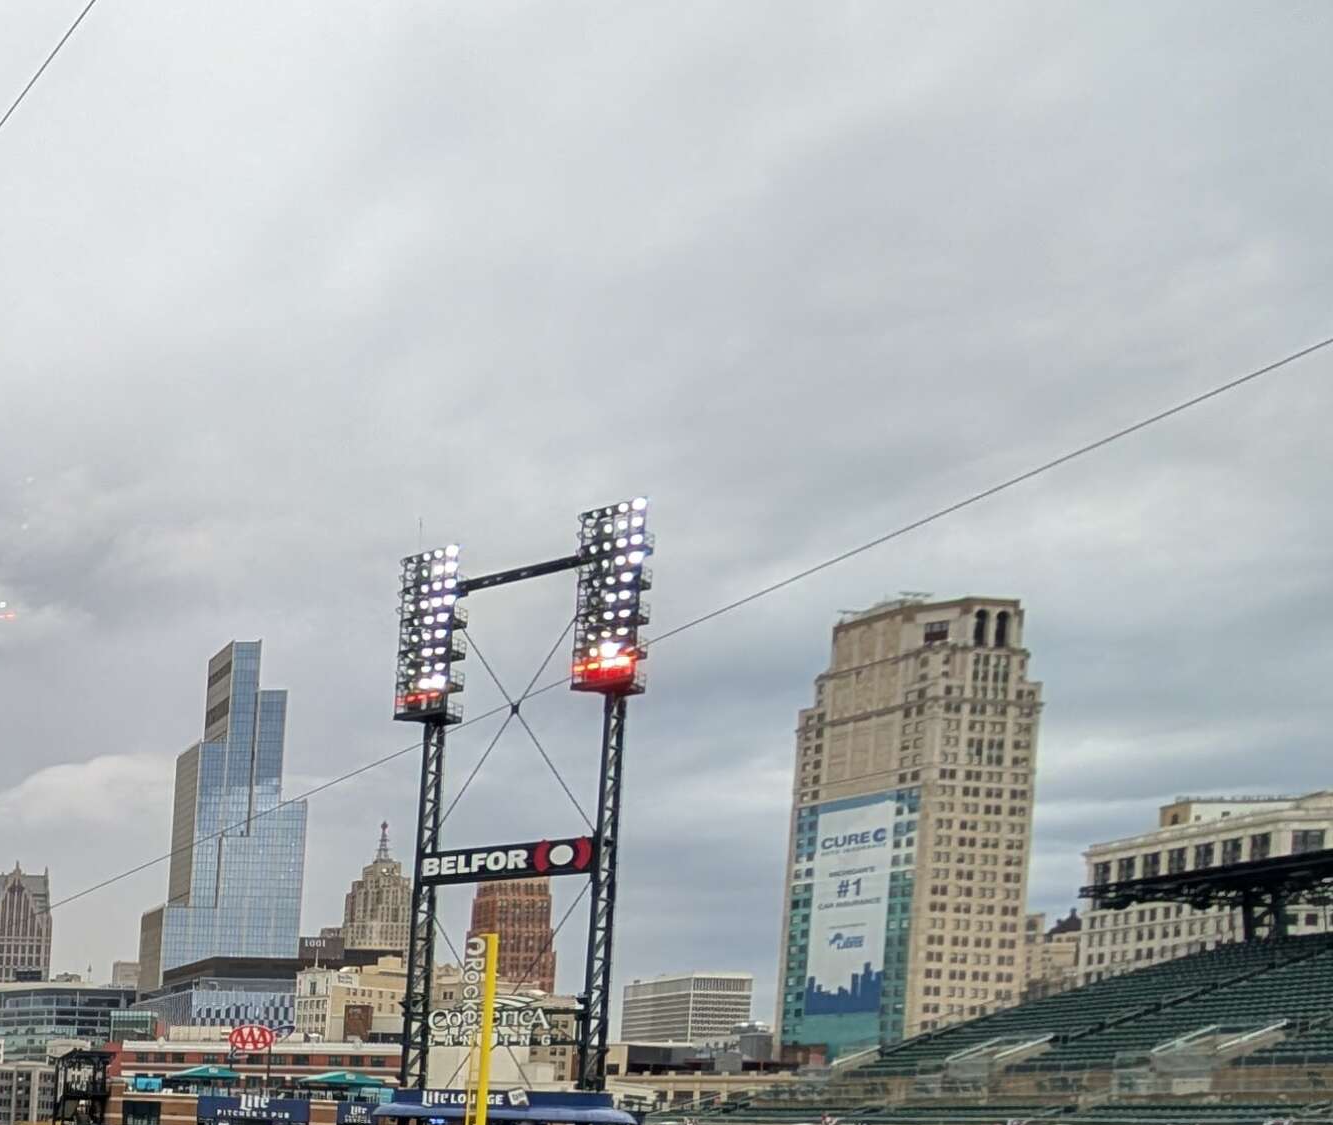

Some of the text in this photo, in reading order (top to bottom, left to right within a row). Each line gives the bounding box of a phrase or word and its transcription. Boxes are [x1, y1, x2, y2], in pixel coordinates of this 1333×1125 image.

[821, 831, 870, 850] CURE
[422, 849, 528, 876] BELFOR
[837, 878, 861, 898] #1
[304, 939, 326, 948] 1001
[462, 956, 486, 1034] Rocket
[235, 1029, 268, 1048] AAA
[239, 1094, 269, 1110] Lite
[217, 1109, 268, 1119] PITCHER'S
